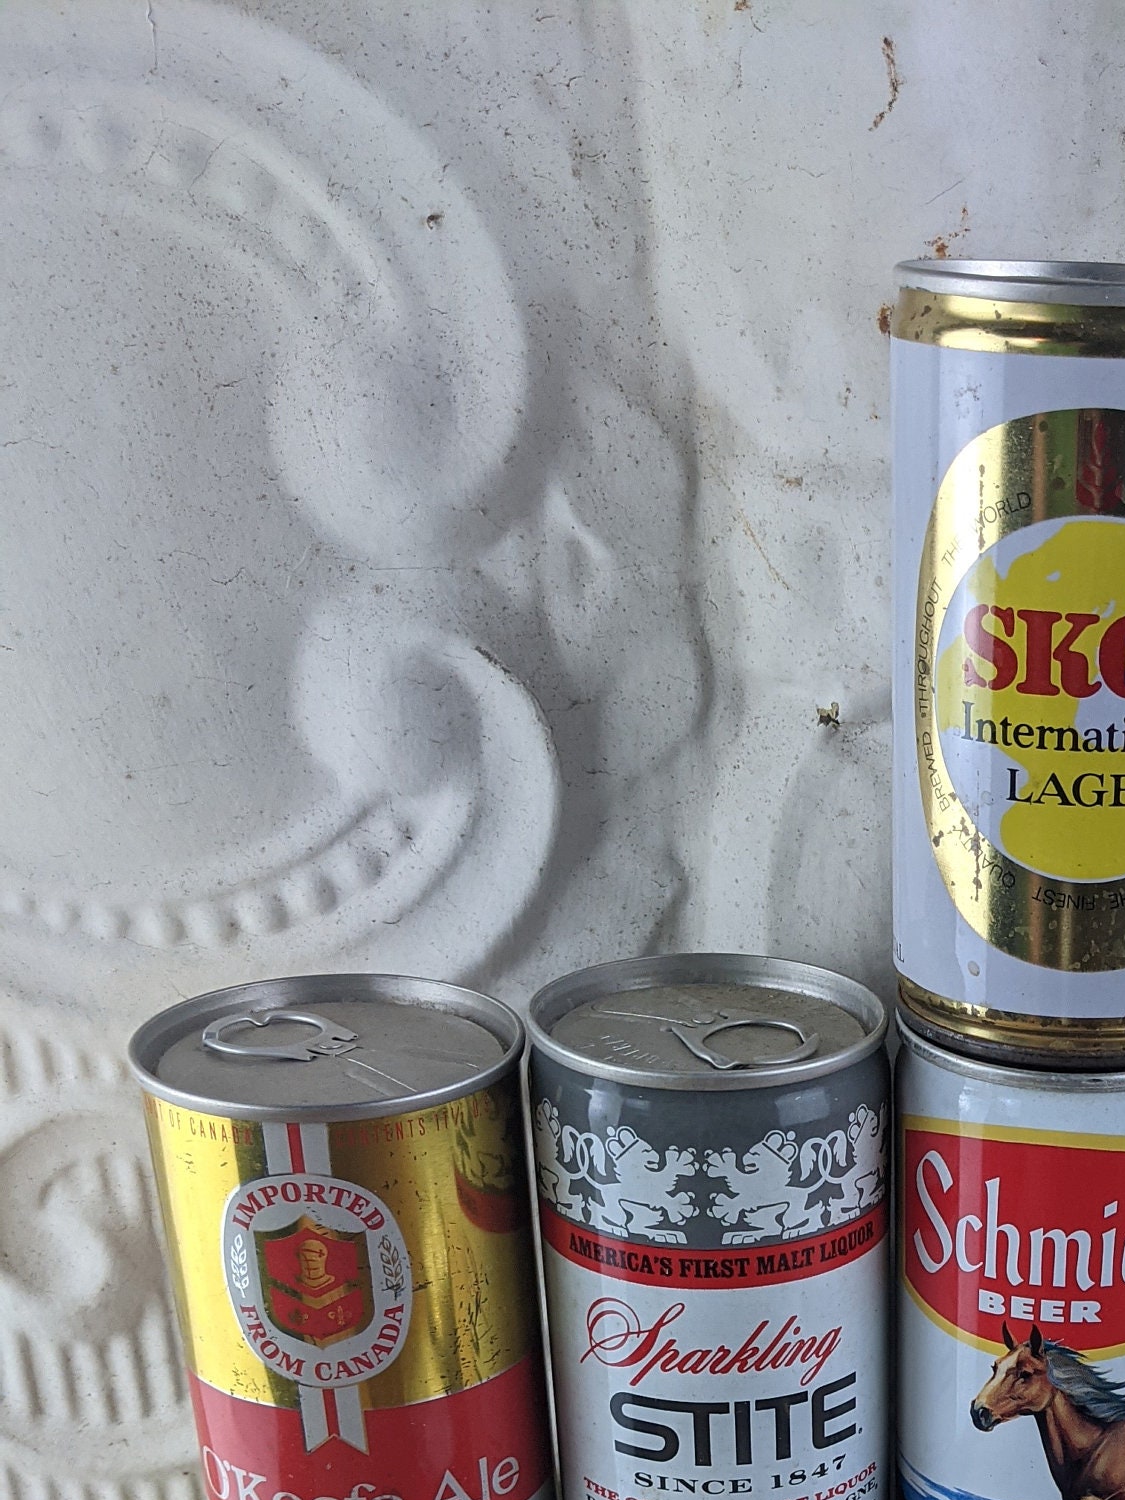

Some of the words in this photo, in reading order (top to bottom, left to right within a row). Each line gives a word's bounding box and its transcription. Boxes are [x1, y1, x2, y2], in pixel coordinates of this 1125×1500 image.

[1032, 886, 1095, 911] FINEST
[232, 1181, 385, 1231] IMPORTED
[569, 1233, 673, 1276] AMERICA'S
[679, 1258, 750, 1278] FIRST
[756, 1246, 815, 1276] MALT
[820, 1221, 875, 1262] LIQUOR
[978, 1288, 1103, 1325] BEER
[240, 1305, 306, 1377] FROM
[314, 1305, 405, 1381] CANADA
[580, 1297, 843, 1386] Sparkling
[609, 1371, 857, 1467] STITE
[634, 1472, 752, 1494] SINCE
[771, 1454, 846, 1489] 1847
